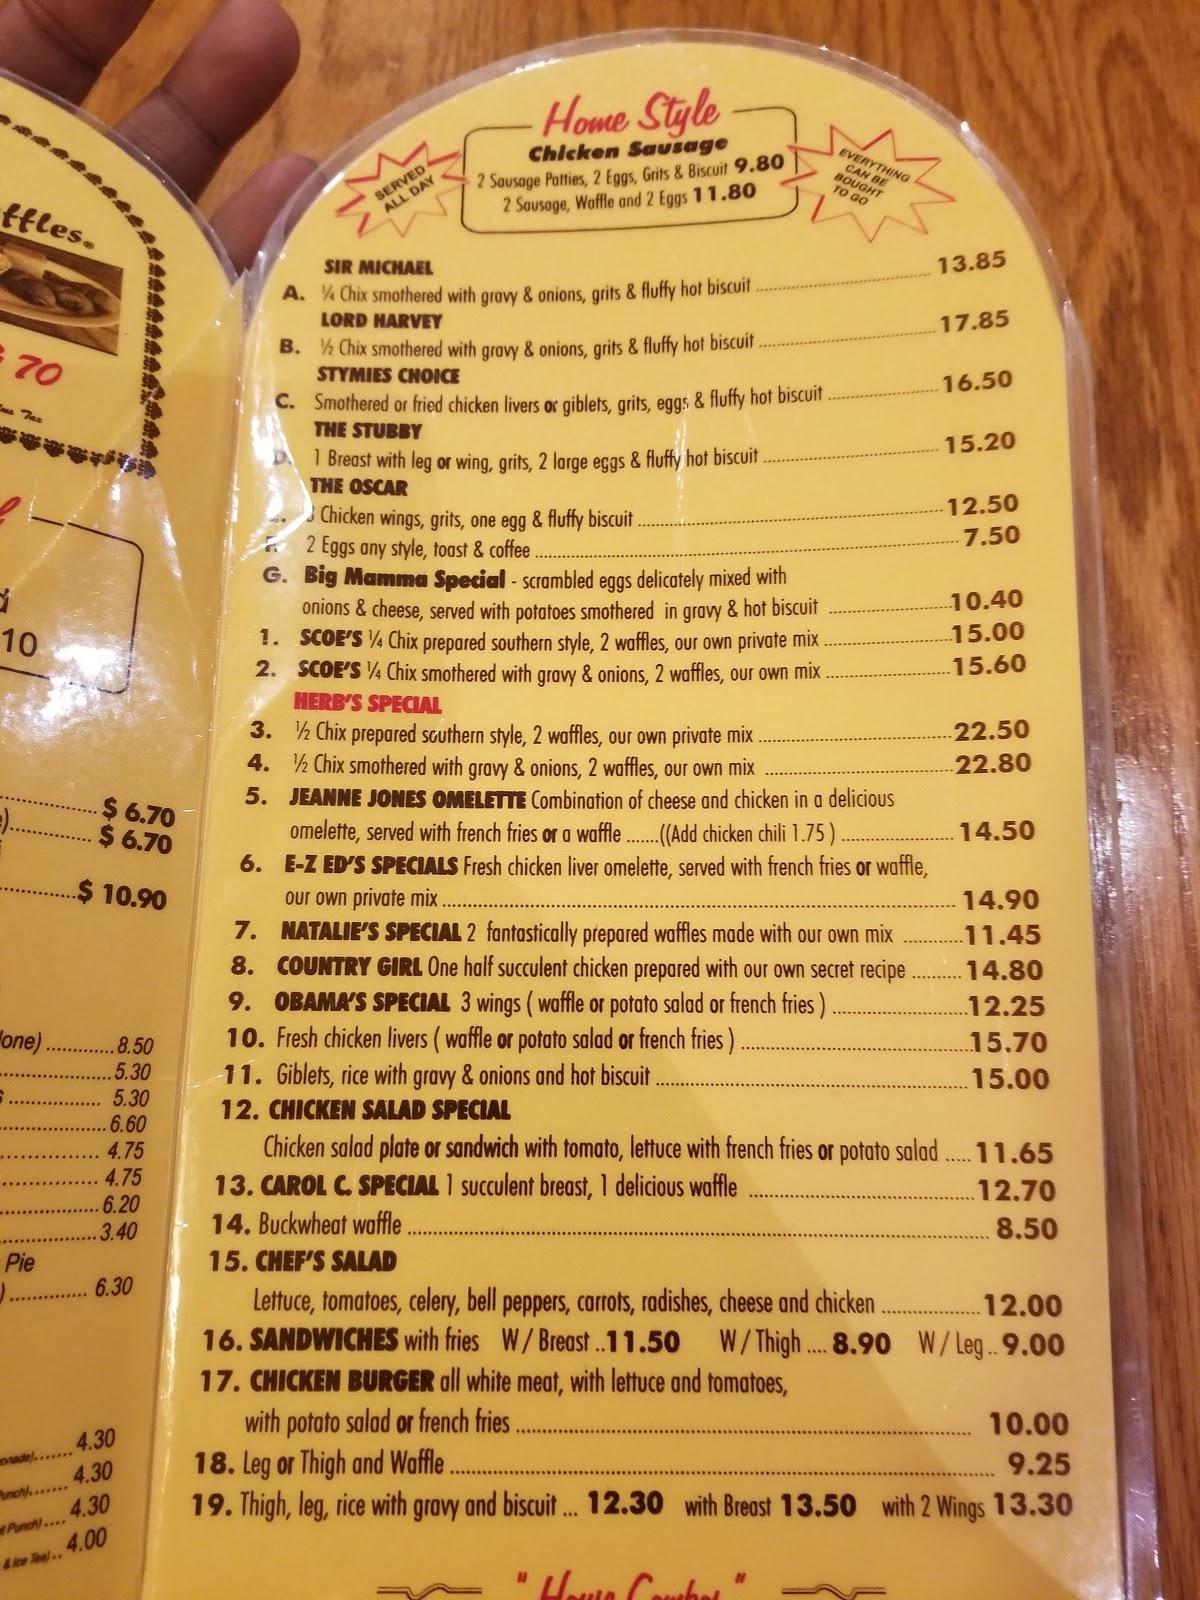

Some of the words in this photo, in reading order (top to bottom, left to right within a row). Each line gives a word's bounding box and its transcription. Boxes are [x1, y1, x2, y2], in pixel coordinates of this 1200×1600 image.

[543, 95, 629, 137] Home
[638, 88, 720, 138] Style
[529, 144, 619, 162] Chicken
[627, 138, 728, 157] Sausage
[478, 173, 484, 188] 2
[490, 174, 540, 191] Sausage
[546, 172, 587, 187] Patties,
[594, 170, 600, 185] 2
[607, 169, 637, 187] Eggs,
[643, 167, 669, 182] Grits
[674, 165, 683, 179] &
[689, 163, 727, 178] Biscuit
[735, 154, 784, 173] 9.80
[839, 148, 911, 183] EVERYTHING
[845, 164, 870, 179] CAN
[870, 174, 889, 187] BE
[374, 165, 426, 201] SERVED
[384, 194, 409, 213] ALL
[409, 174, 434, 197] DAY
[833, 172, 884, 198] BOUGHT
[504, 197, 510, 212] 2
[516, 197, 569, 214] Sausage,
[576, 193, 614, 209] Waffle
[619, 192, 641, 208] and
[647, 192, 653, 206] 2
[660, 190, 687, 208] Eggs
[694, 182, 756, 203] 11.80
[832, 185, 848, 197] TO
[850, 192, 869, 206] GO
[324, 259, 353, 274] SIR
[358, 260, 433, 275] MICHAEL
[321, 312, 367, 328] LORD
[374, 313, 443, 329] HARVEY
[15, 354, 63, 386] 70
[317, 366, 392, 383] STYMIES
[398, 368, 460, 384] CHOICE
[315, 393, 388, 411] Smothered
[394, 400, 407, 412] or
[413, 394, 443, 413] fried
[449, 395, 498, 413] chicken
[505, 395, 539, 413] livers
[544, 400, 558, 413] or
[563, 394, 611, 417] giblets,
[618, 395, 651, 416] grits,
[657, 397, 688, 414] eggs
[695, 392, 704, 408] &
[710, 388, 745, 410] fluffy
[751, 387, 772, 405] hot
[778, 385, 822, 403] biscuit
[943, 370, 1012, 392] 16.50
[314, 421, 347, 438] THE
[352, 422, 423, 440] STUBBY
[310, 477, 344, 494] THE
[349, 478, 408, 496] OSCAR
[307, 535, 315, 552] 2
[322, 535, 355, 558] Eggs
[360, 543, 386, 560] any
[392, 538, 427, 560] style,
[434, 542, 468, 557] toast
[474, 541, 484, 558] &
[490, 539, 530, 558] coffee
[964, 525, 1020, 546] 7.50
[294, 692, 362, 712] HERB'S
[368, 695, 442, 714] SPECIAL
[125, 802, 175, 827] 6.70
[122, 830, 172, 854] 6.70
[103, 884, 167, 910] 10.90
[277, 956, 372, 976] COUNTRY
[377, 957, 423, 976] GIRL
[428, 956, 458, 976] One
[464, 955, 494, 977] half
[498, 956, 568, 977] succulent
[573, 956, 628, 977] chicken
[635, 956, 700, 982] prepared
[706, 956, 737, 977] with
[744, 964, 768, 978] our
[774, 964, 804, 978] own
[811, 961, 854, 978] secret
[861, 959, 905, 983] recipe
[967, 960, 1043, 981] 14.80
[117, 1036, 154, 1055] 8.50
[115, 1062, 151, 1081] 5.30
[113, 1089, 150, 1107] 5.30
[269, 1099, 356, 1120] CHICKEN
[362, 1099, 426, 1120] SALAD
[432, 1099, 511, 1120] SPECIAL
[110, 1115, 147, 1133] 6.60
[108, 1141, 144, 1159] 4.75
[105, 1168, 142, 1187] 4.75
[261, 1175, 327, 1196] CAROL
[358, 1174, 439, 1196] SPECIAL
[447, 1173, 452, 1196] 1
[461, 1172, 534, 1196] succulent
[540, 1172, 592, 1200] breast,
[601, 1174, 606, 1196] 1
[616, 1173, 684, 1197] delicious
[689, 1173, 737, 1197] waffle
[978, 1179, 1056, 1202] 12.70
[103, 1195, 140, 1214] 6.20
[100, 1221, 138, 1241] 3.40
[259, 1211, 347, 1235] Buckwheat
[353, 1210, 401, 1235] waffle
[997, 1217, 1058, 1240] 8.50
[5, 1252, 35, 1273] Pie
[256, 1250, 325, 1272] CHEF'S
[331, 1250, 397, 1272] SALAD
[95, 1276, 133, 1297] 6.30
[76, 1428, 115, 1451] 4.30
[73, 1460, 113, 1484] 4.30
[244, 1450, 271, 1480] Leg
[277, 1456, 295, 1475] or
[300, 1449, 345, 1480] Thigh
[352, 1449, 384, 1474] and
[390, 1448, 444, 1474] Waffle
[1008, 1452, 1071, 1476] 9.25
[70, 1493, 110, 1518] 4.30
[240, 1490, 291, 1522] Thigh,
[299, 1490, 328, 1522] leg,
[337, 1493, 365, 1516] rice
[372, 1490, 407, 1516] with
[414, 1499, 459, 1522] gravy
[465, 1490, 496, 1516] and
[504, 1490, 557, 1517] biscuit
[588, 1490, 663, 1515] 12.30
[685, 1493, 717, 1516] with
[724, 1493, 772, 1517] Breast
[781, 1493, 856, 1517] 13.50
[882, 1493, 915, 1517] with
[921, 1494, 930, 1517] 2
[936, 1495, 985, 1523] Wings
[994, 1492, 1073, 1516] 13.30
[66, 1527, 107, 1552] 4.00
